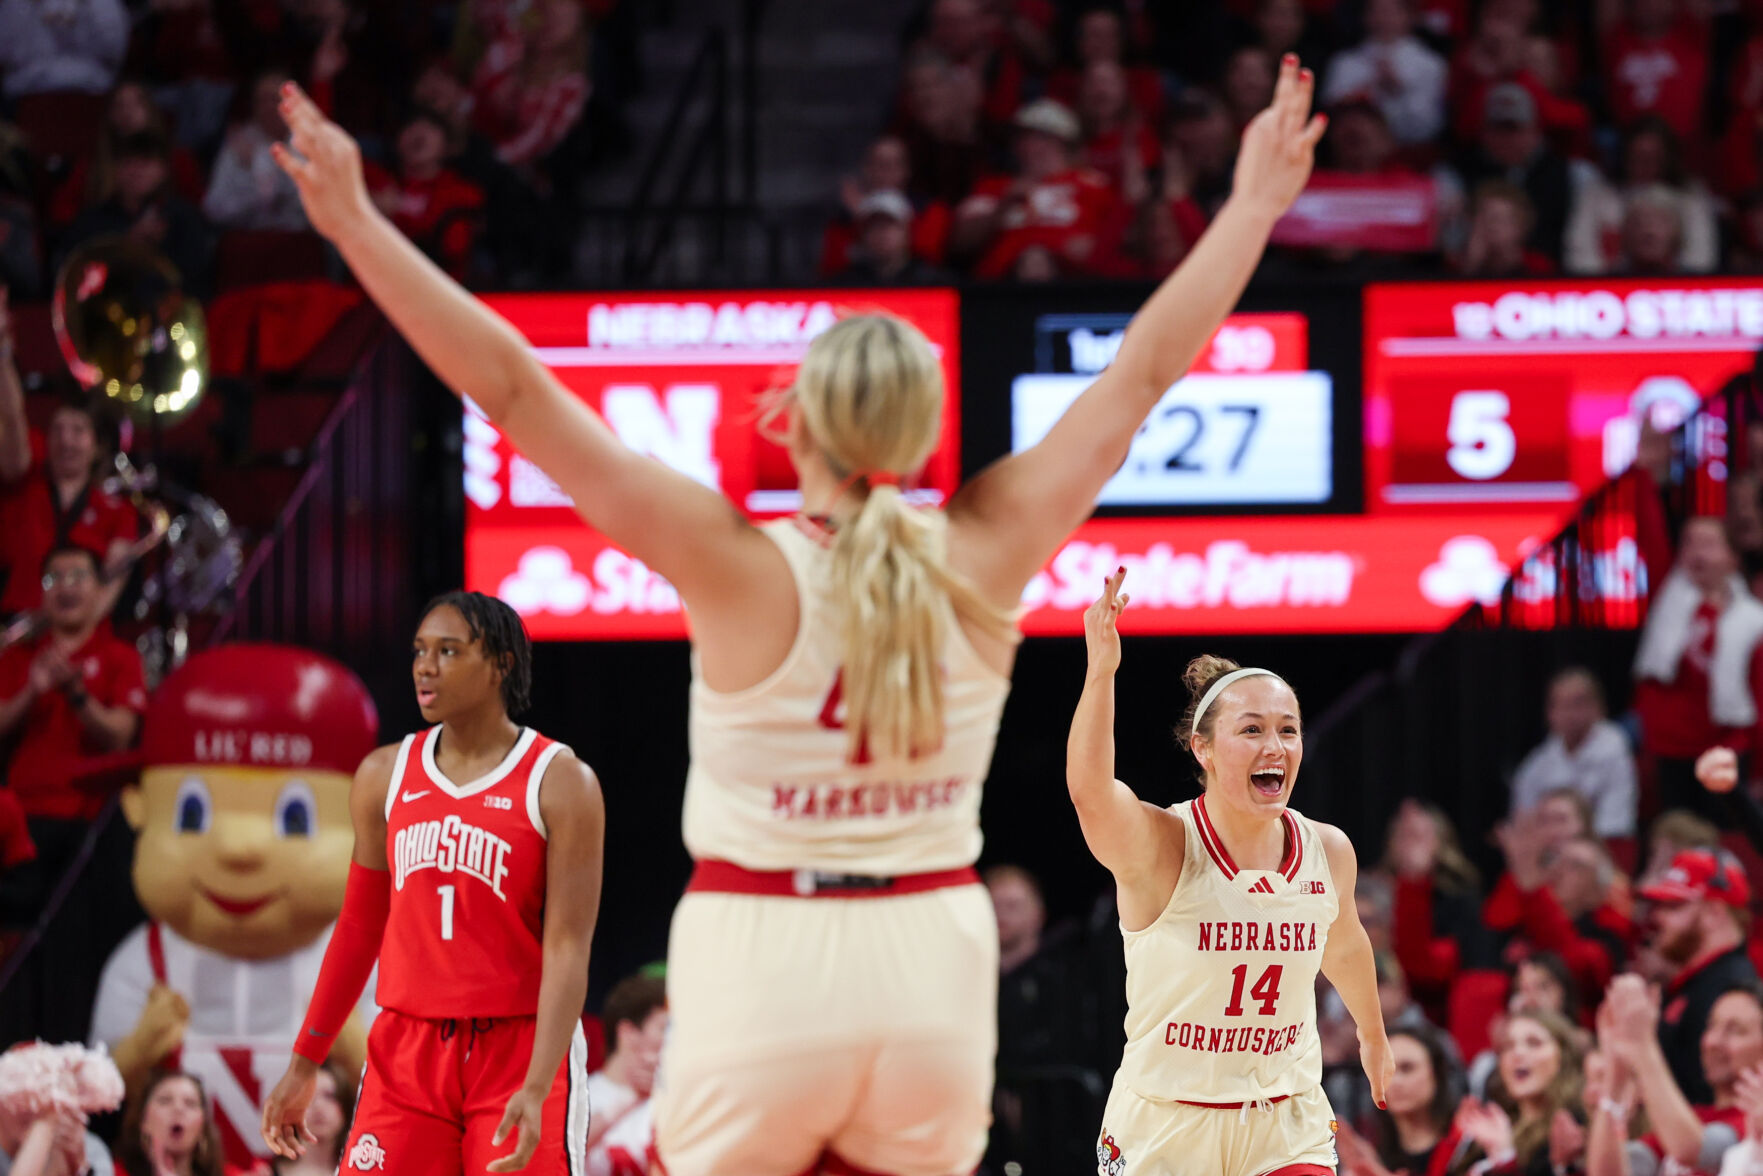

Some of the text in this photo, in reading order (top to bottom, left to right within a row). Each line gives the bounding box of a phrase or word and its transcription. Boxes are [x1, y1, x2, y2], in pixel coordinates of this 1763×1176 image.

[588, 303, 836, 347] NEBRASKA
[1494, 291, 1626, 340] OHIO
[1626, 289, 1763, 338] STATE
[1134, 404, 1264, 473] :27
[1447, 390, 1517, 481] 5
[437, 885, 455, 940] 1
[1198, 921, 1317, 952] NEBRASKA
[1224, 963, 1284, 1017] 14
[1165, 1021, 1304, 1056] CORNHUSKER
